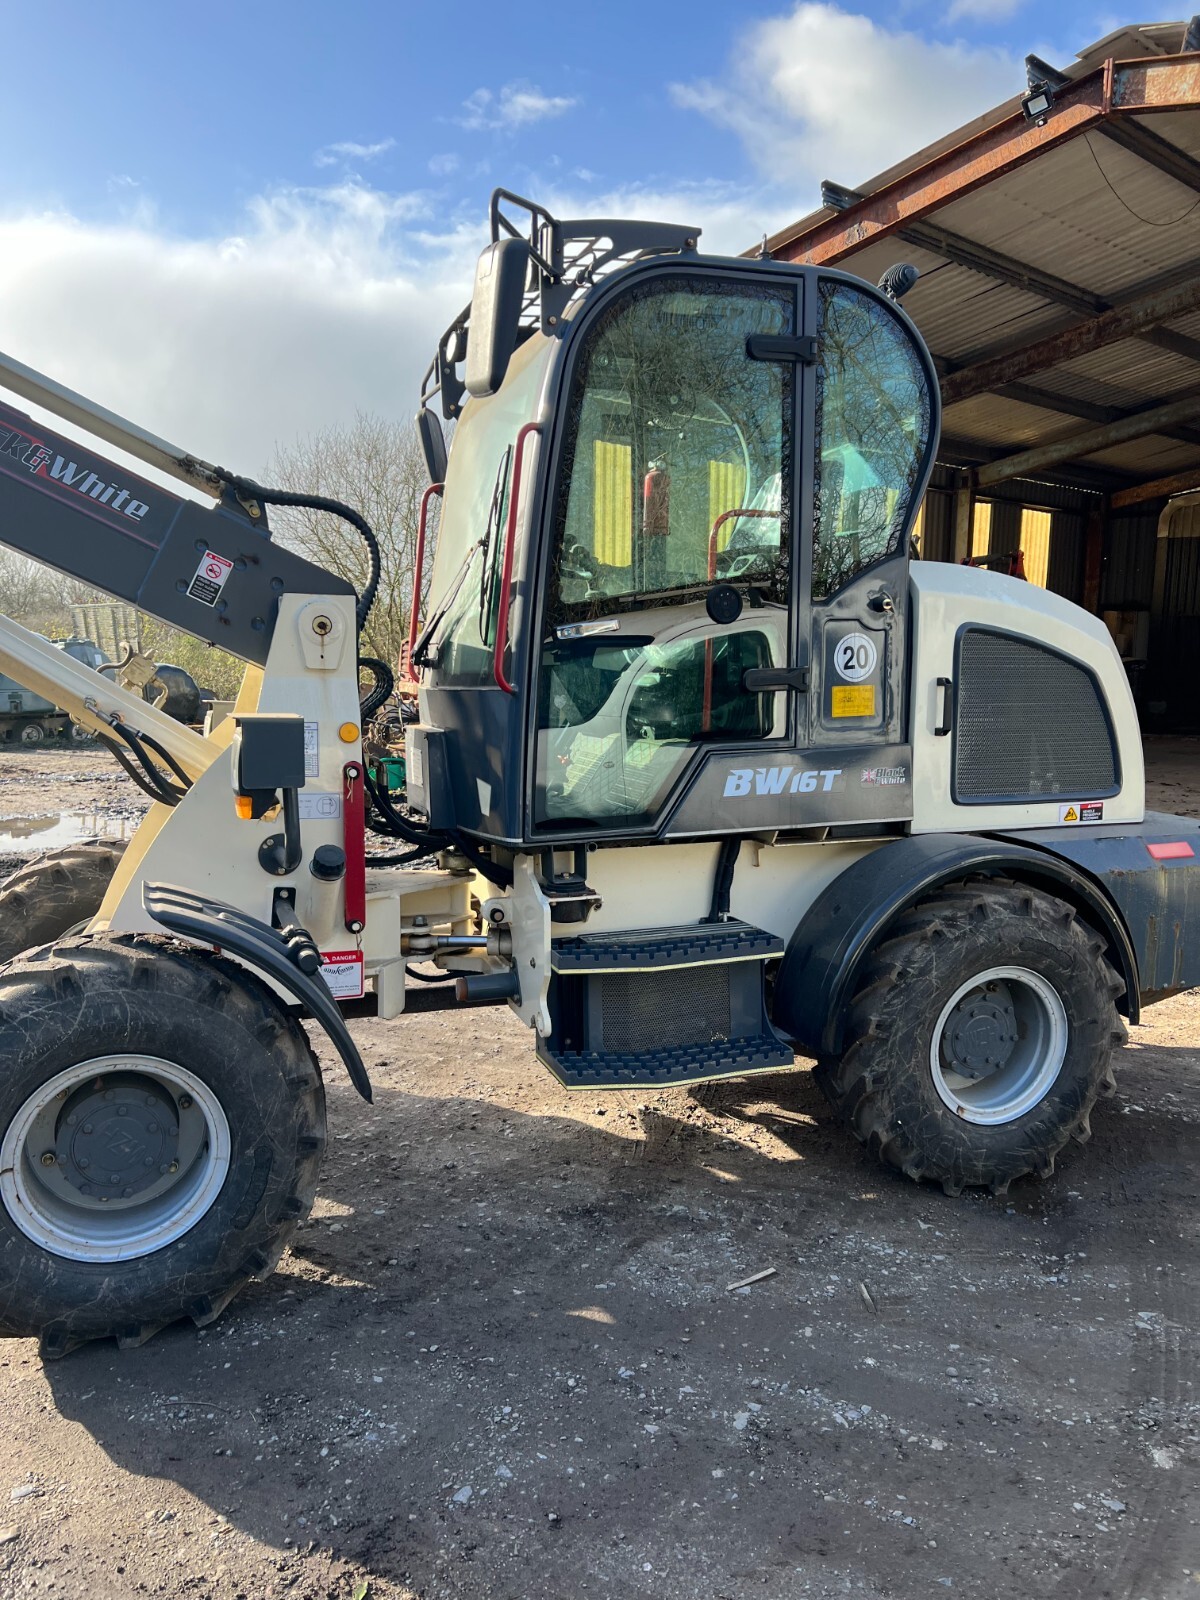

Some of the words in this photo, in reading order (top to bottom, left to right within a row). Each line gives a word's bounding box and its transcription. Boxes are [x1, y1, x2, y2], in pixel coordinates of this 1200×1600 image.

[0, 429, 150, 521] k&White
[843, 644, 869, 671] 20
[723, 766, 842, 797] BW16T
[875, 766, 906, 777] Black
[331, 954, 357, 962] DANGER
